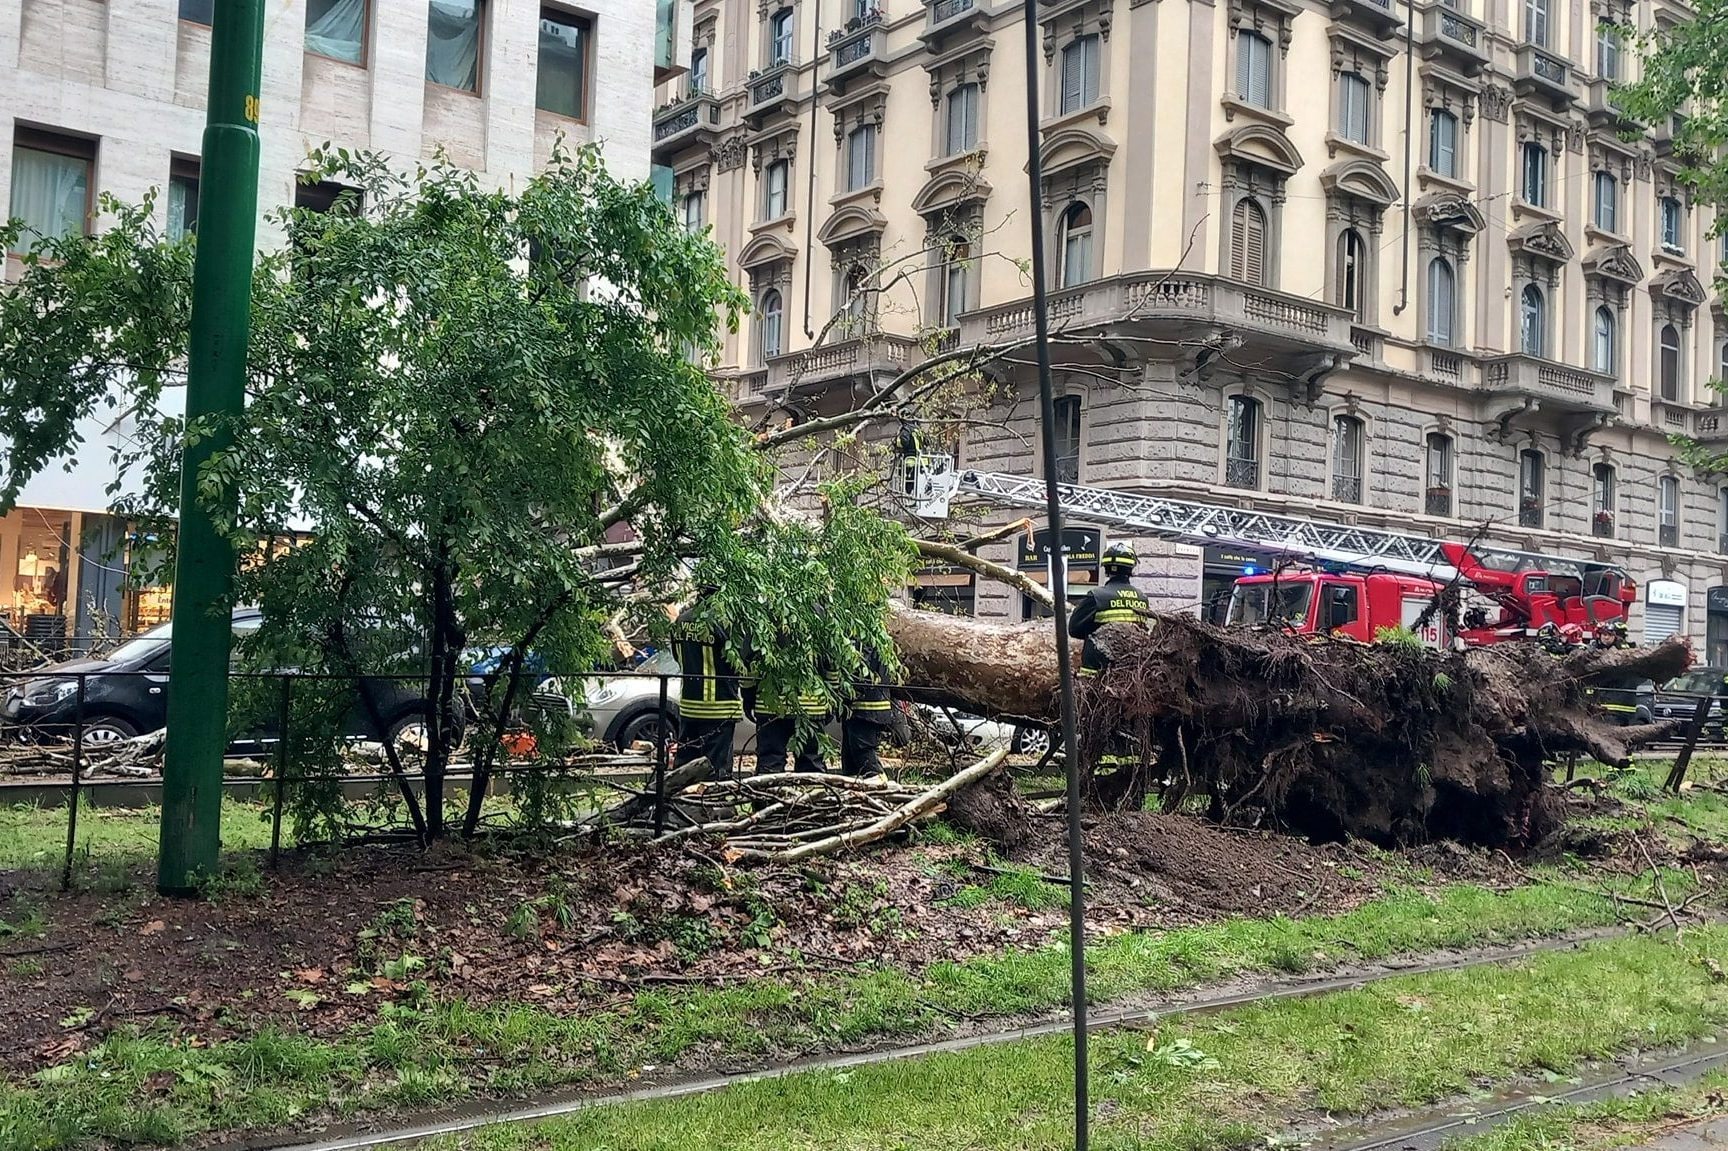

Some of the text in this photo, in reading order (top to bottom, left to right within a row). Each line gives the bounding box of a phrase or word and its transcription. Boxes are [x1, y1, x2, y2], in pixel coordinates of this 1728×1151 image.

[1117, 590, 1138, 598] VIGILI
[1110, 599, 1147, 609] DEL FUOCO
[1420, 626, 1438, 642] 115
